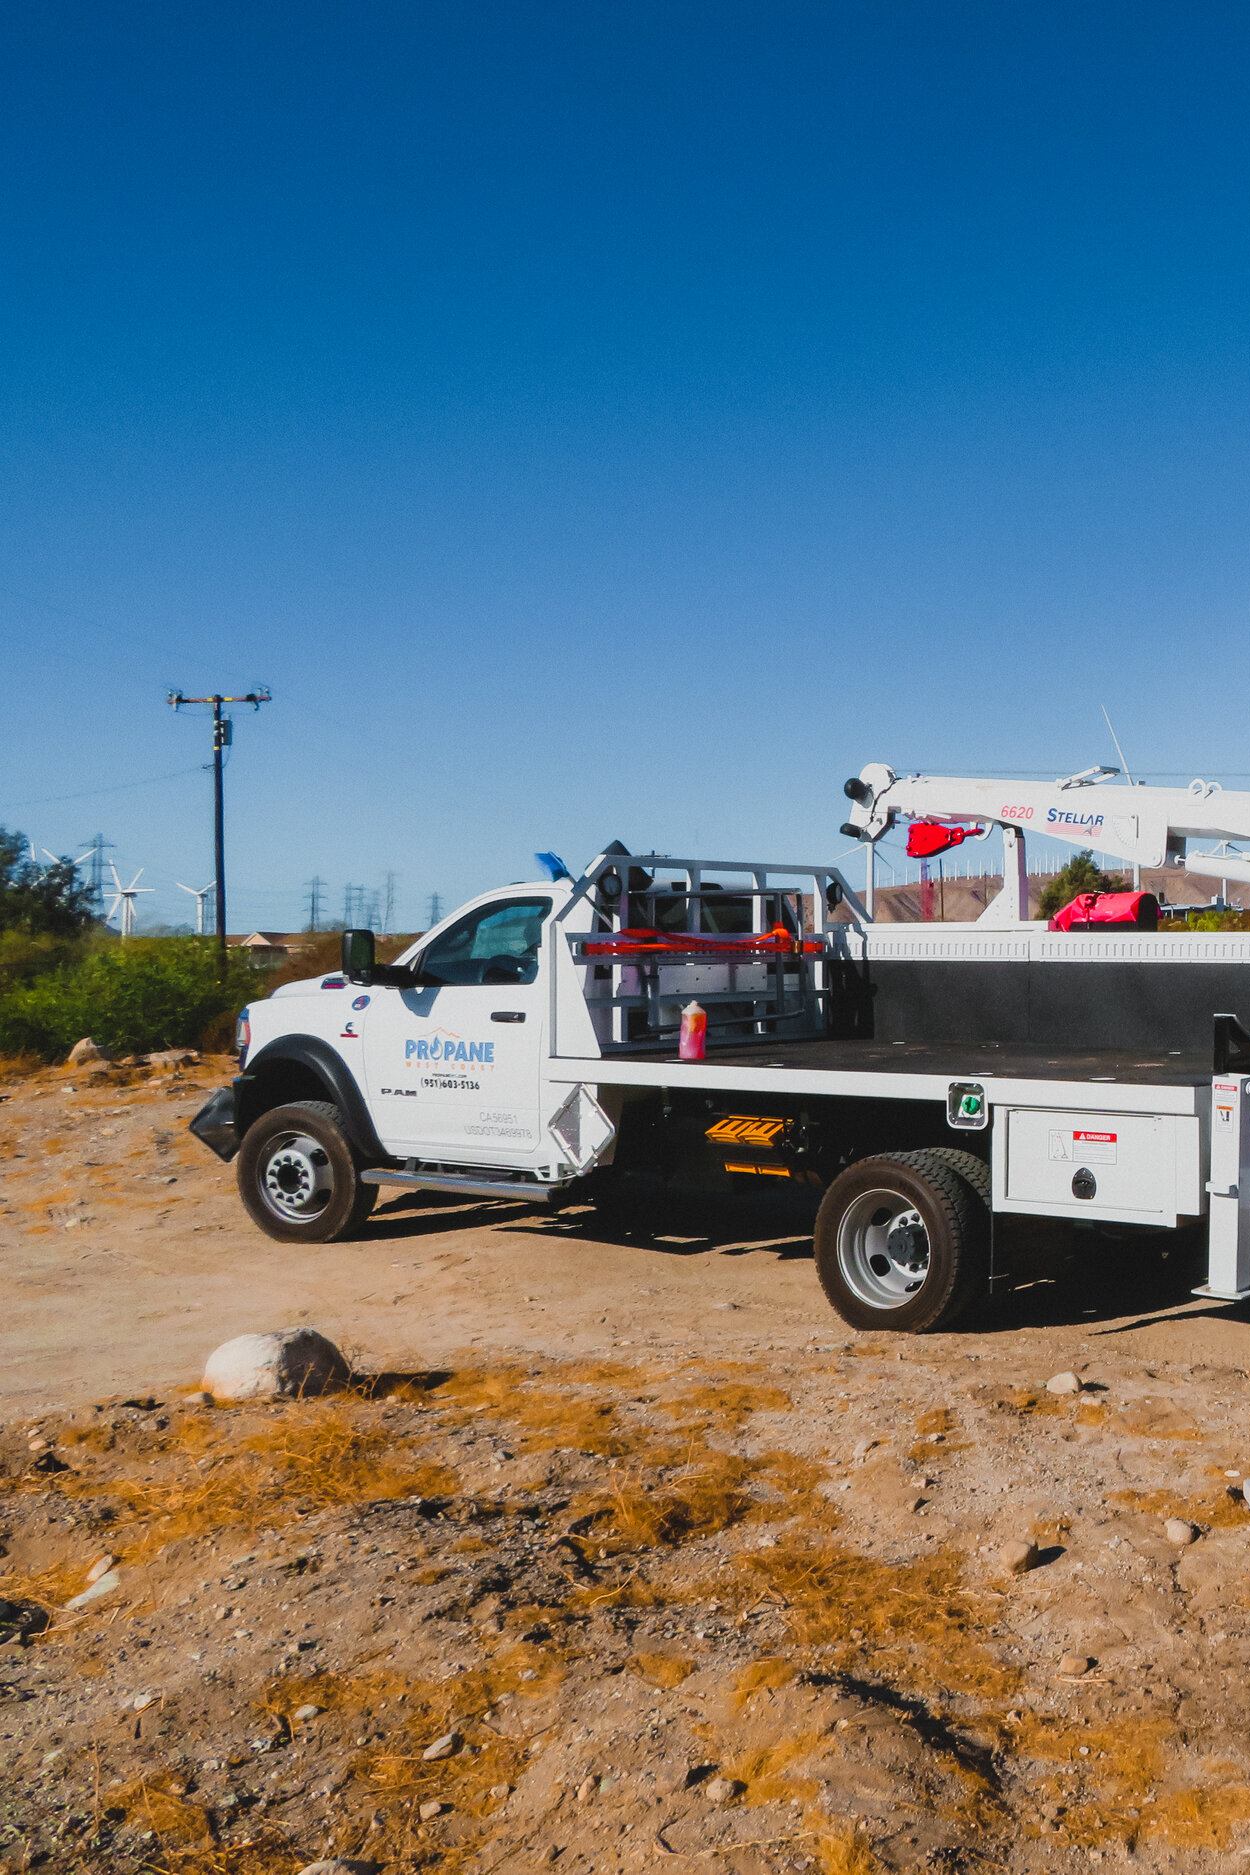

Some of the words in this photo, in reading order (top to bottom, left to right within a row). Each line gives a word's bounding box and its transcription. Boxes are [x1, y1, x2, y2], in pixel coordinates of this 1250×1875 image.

[1001, 805, 1034, 820] 6620
[405, 1036, 495, 1062] PROPANE
[405, 1061, 439, 1070] WEST
[450, 1063, 495, 1072] COAST
[1086, 1133, 1111, 1141] DANGER
